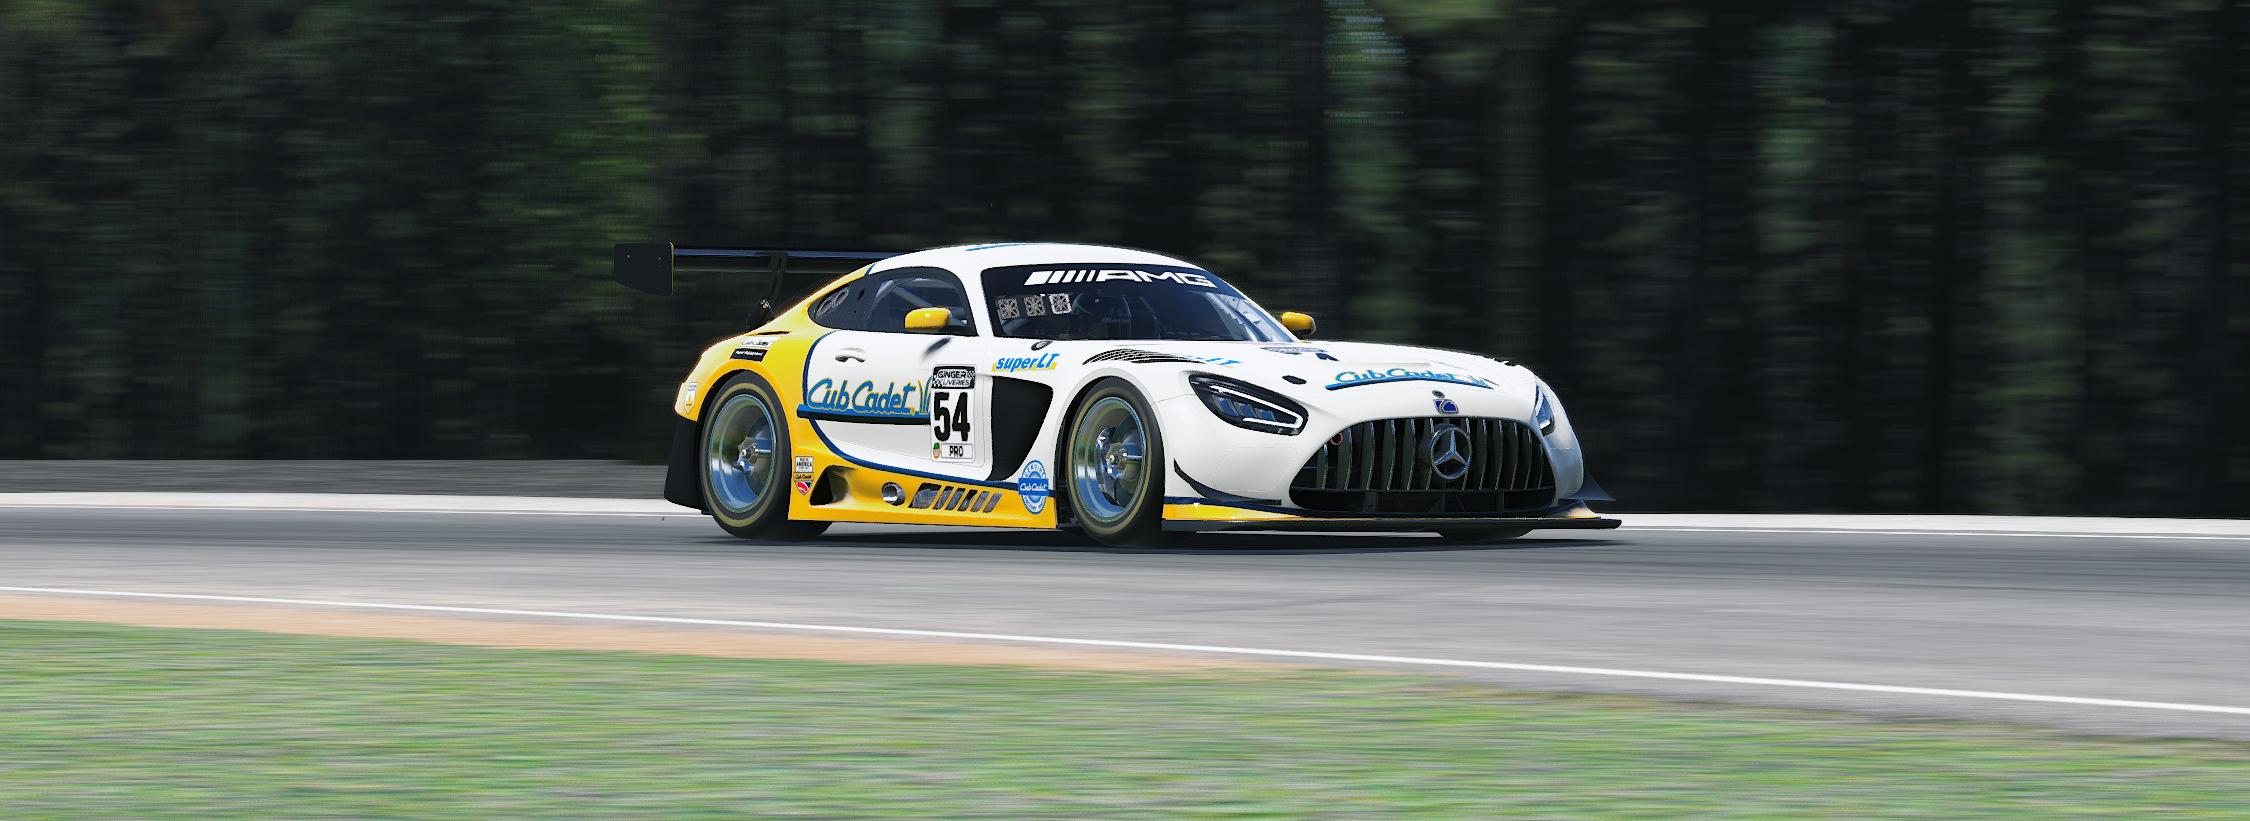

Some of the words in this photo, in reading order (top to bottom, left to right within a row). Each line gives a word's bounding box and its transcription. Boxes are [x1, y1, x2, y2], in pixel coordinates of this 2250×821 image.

[996, 353, 1060, 372] superLT
[1335, 369, 1385, 384] Cub
[807, 377, 849, 410] Cub
[852, 379, 916, 414] Cadet
[934, 392, 970, 441] 54
[949, 445, 964, 457] PRO
